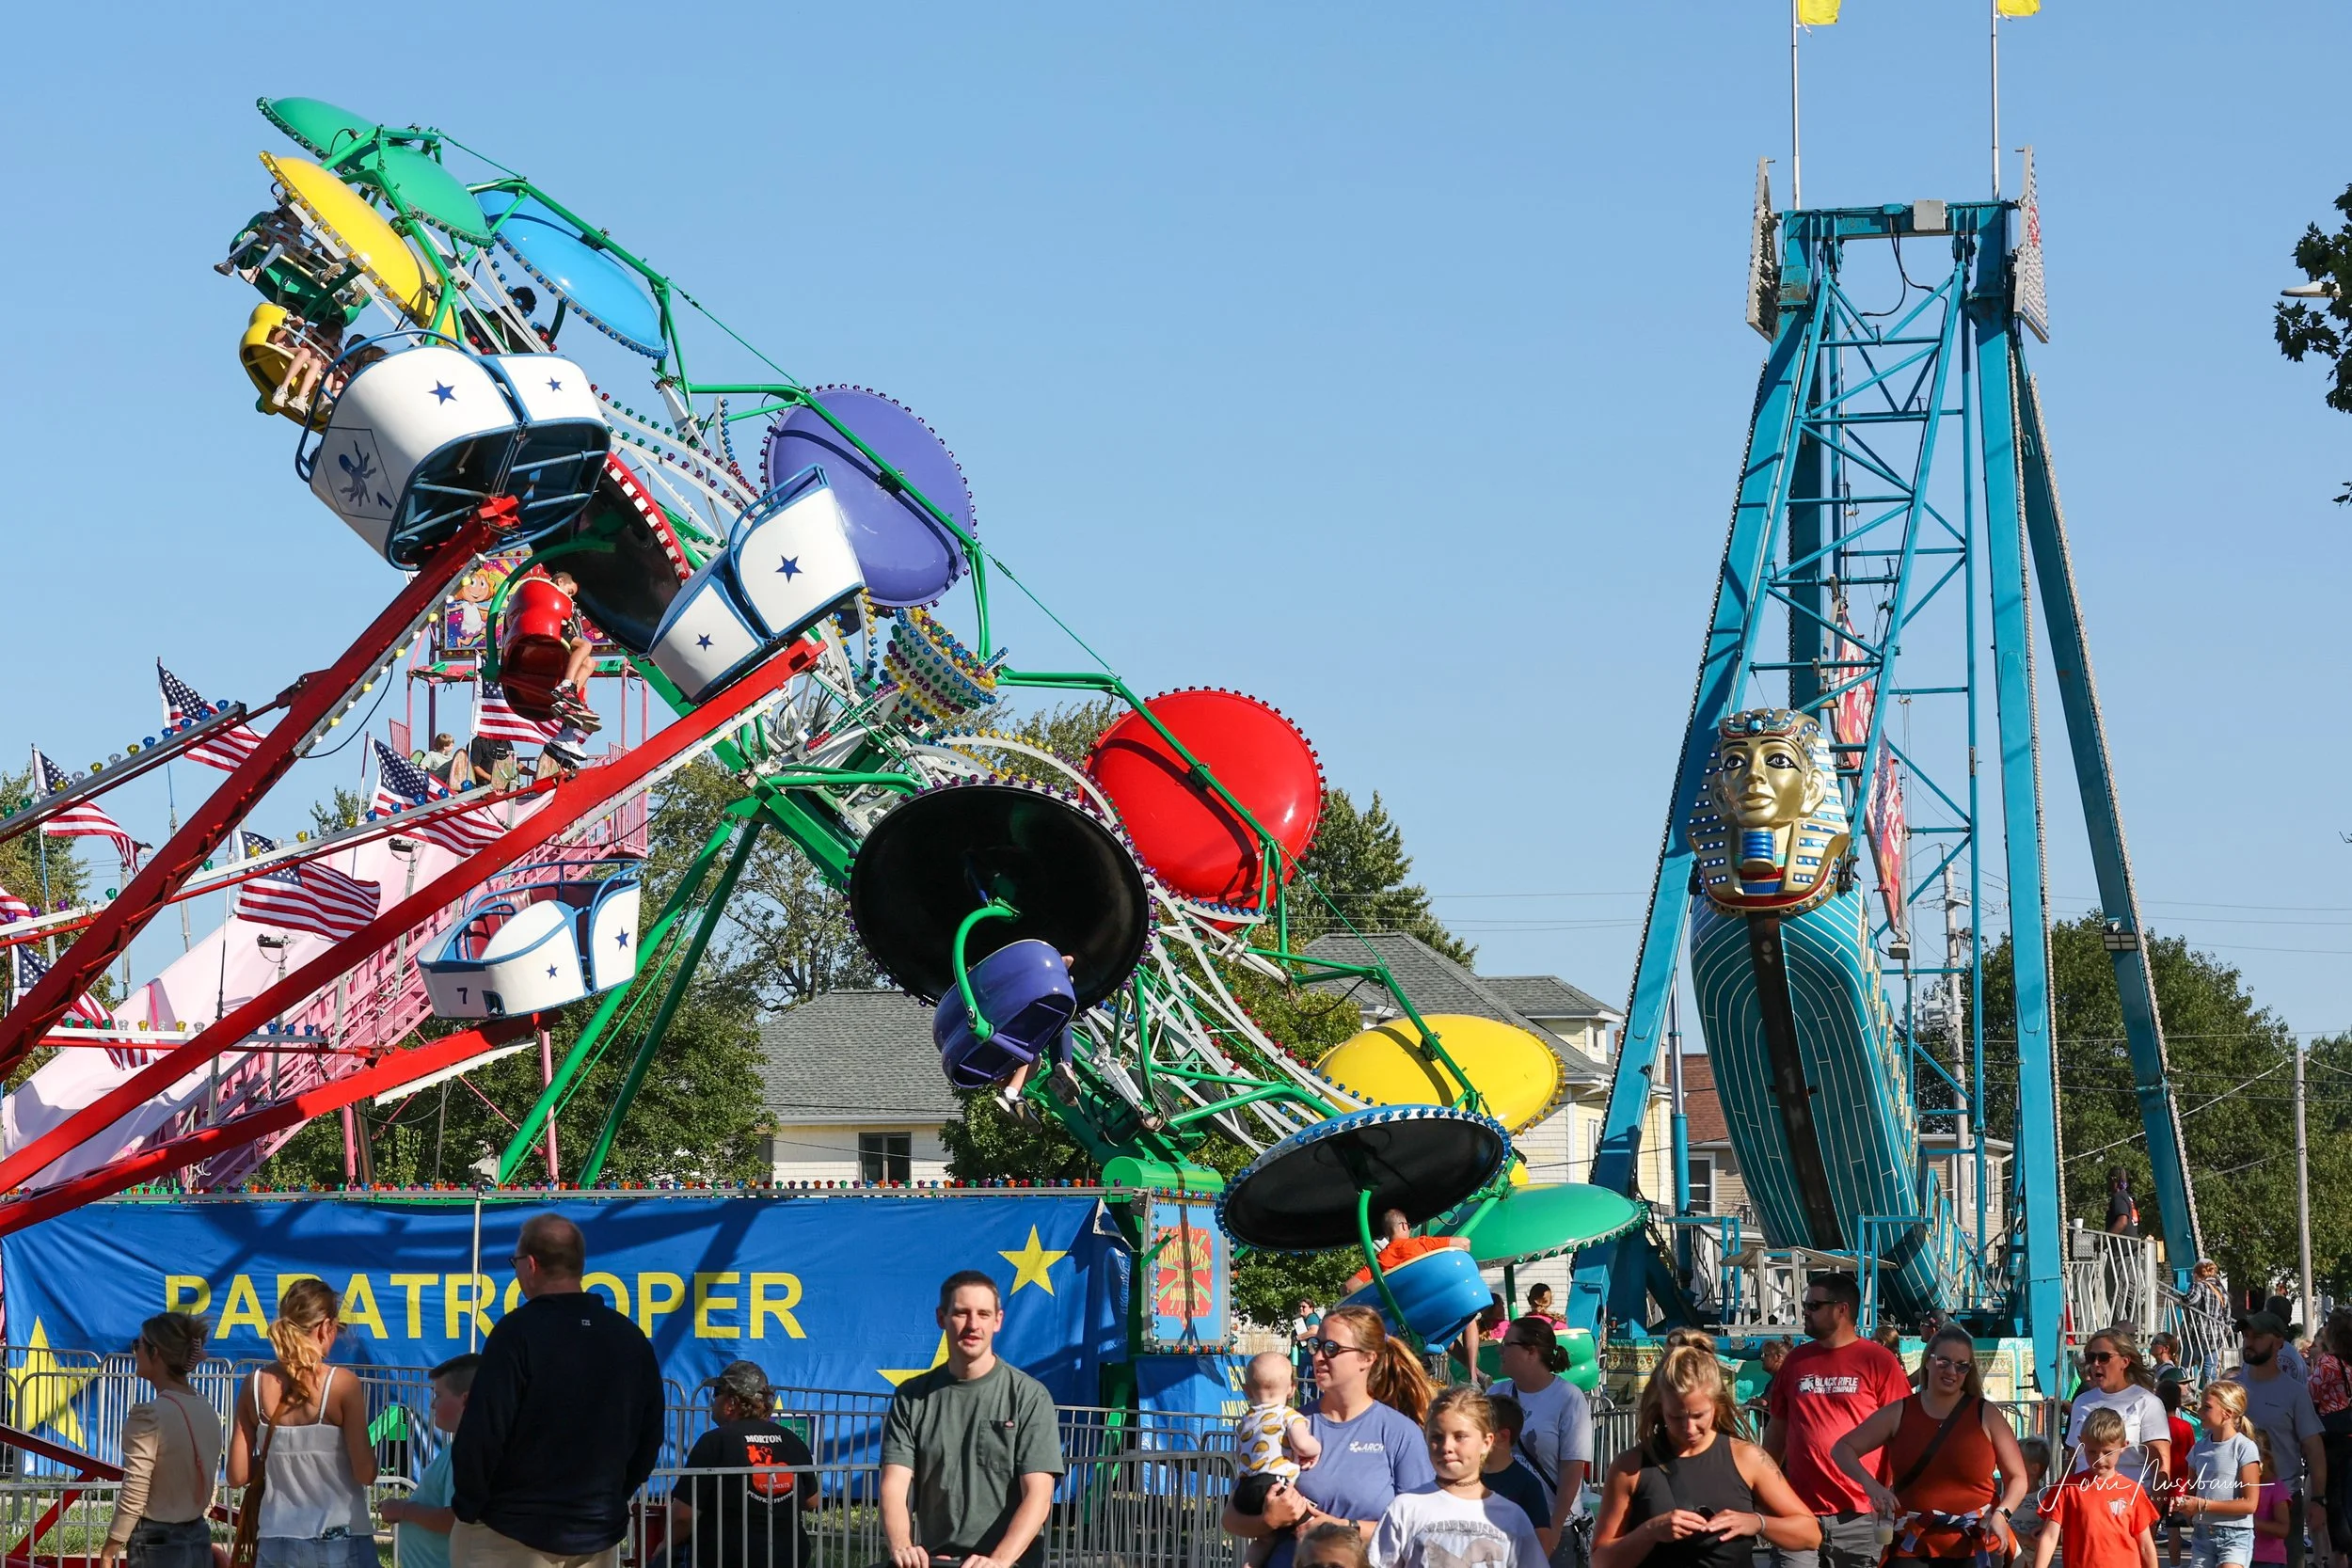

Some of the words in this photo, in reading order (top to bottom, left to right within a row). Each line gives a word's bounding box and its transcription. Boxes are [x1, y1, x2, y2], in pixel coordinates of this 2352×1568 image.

[456, 988, 468, 1005] 7
[1815, 1376, 1837, 1387] BLACK
[1837, 1376, 1859, 1386] RIFLE
[744, 1434, 783, 1444] MORTON
[1362, 1443, 1384, 1451] ARCH
